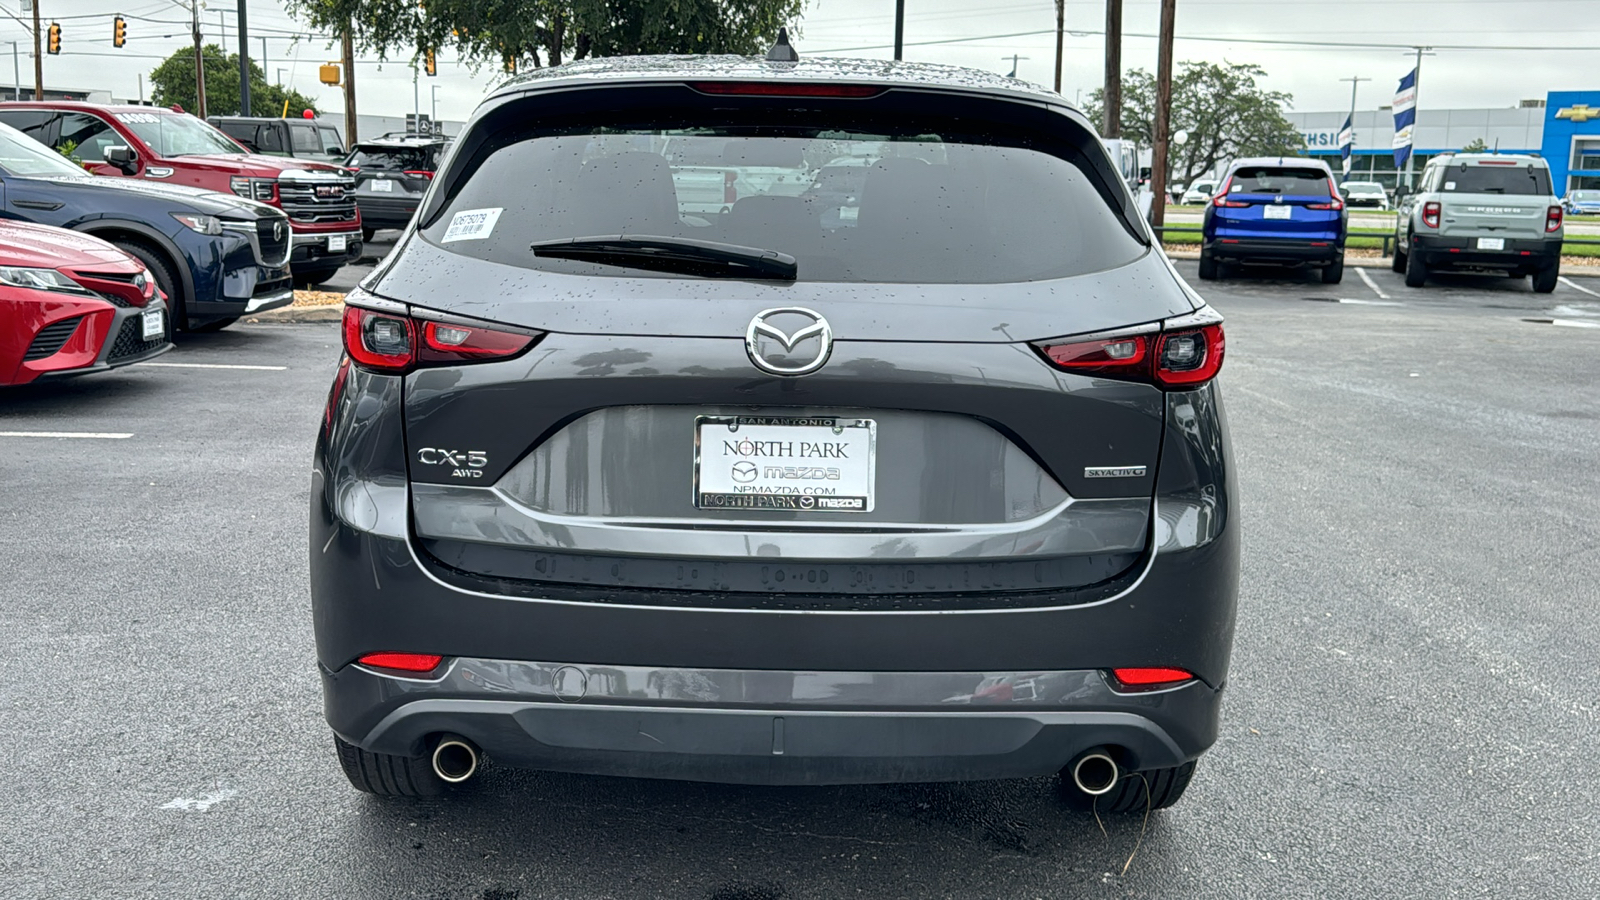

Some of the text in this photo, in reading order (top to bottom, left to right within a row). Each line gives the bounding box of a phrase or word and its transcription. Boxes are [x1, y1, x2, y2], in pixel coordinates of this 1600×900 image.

[770, 418, 833, 426] ANTONIO
[723, 438, 849, 458] NORTH PARK
[417, 447, 488, 468] CX-5
[451, 469, 483, 478] AWD
[704, 494, 754, 508] NORTH
[758, 496, 796, 508] PARK
